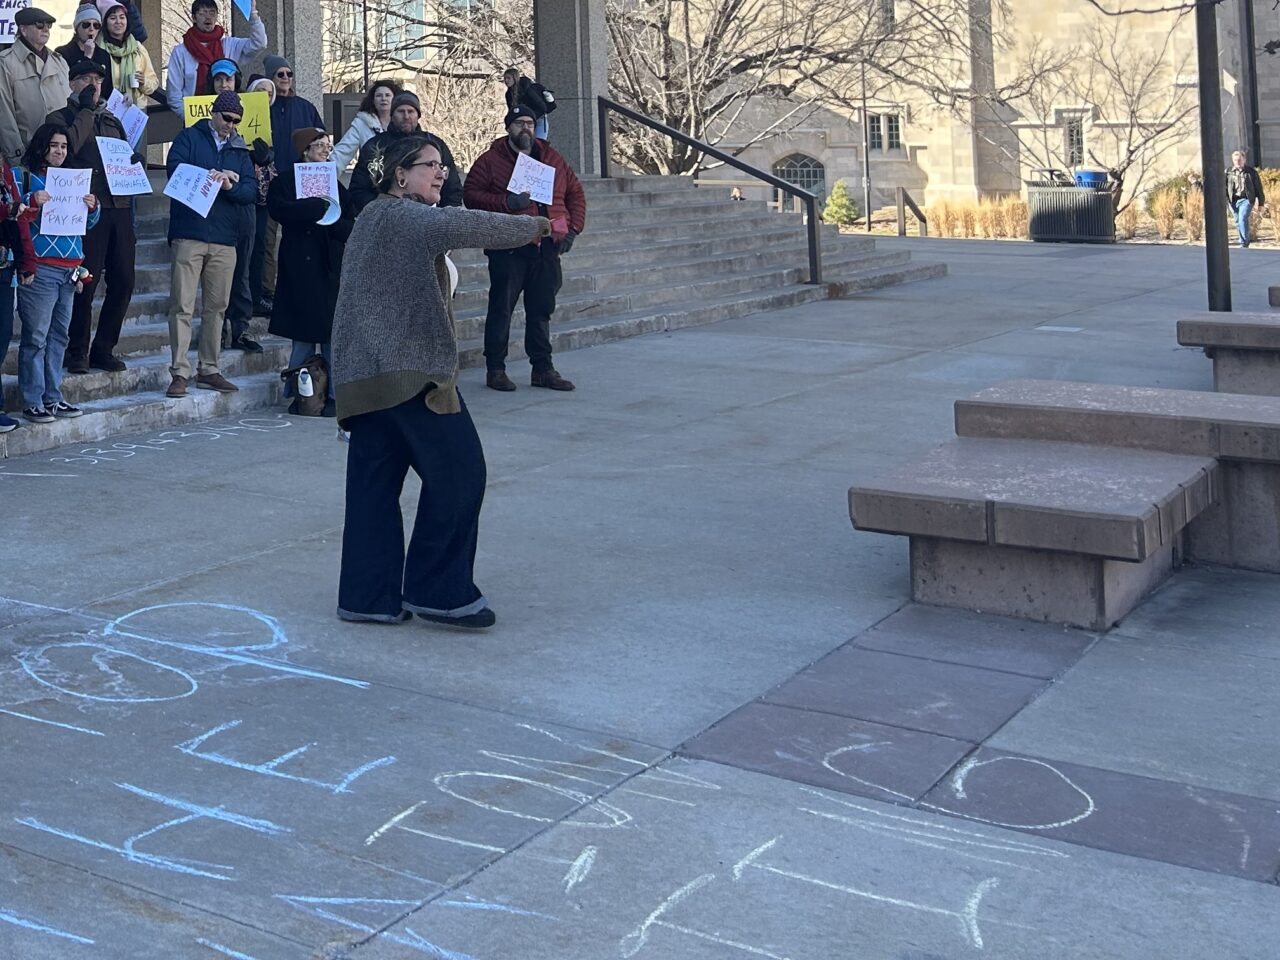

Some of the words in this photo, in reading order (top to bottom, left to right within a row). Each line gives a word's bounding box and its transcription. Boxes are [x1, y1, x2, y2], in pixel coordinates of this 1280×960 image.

[189, 104, 213, 117] UAK
[248, 114, 261, 134] 4
[51, 174, 72, 187] YOU
